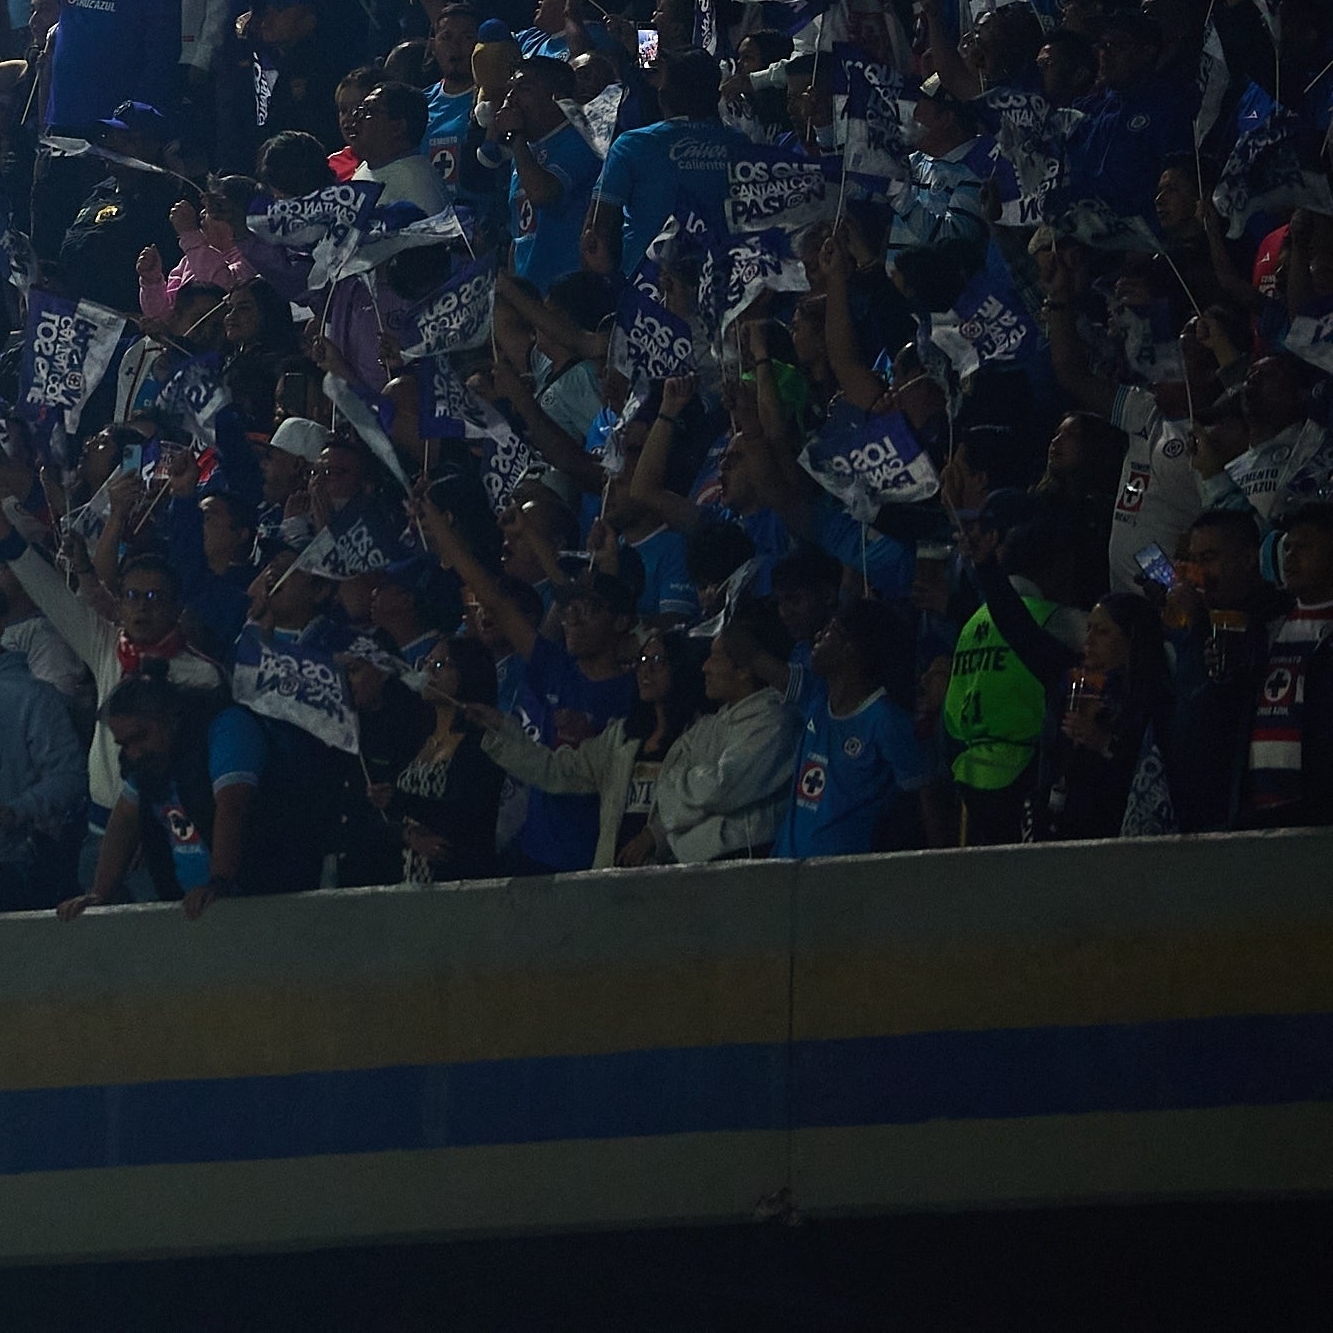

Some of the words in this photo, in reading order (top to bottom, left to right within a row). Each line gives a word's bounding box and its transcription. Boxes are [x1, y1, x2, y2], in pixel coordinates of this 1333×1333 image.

[429, 136, 458, 146] CEMENTO
[728, 161, 770, 185] LOS
[771, 162, 822, 179] QUE
[730, 179, 789, 197] CANTAN
[635, 308, 674, 348] LOS
